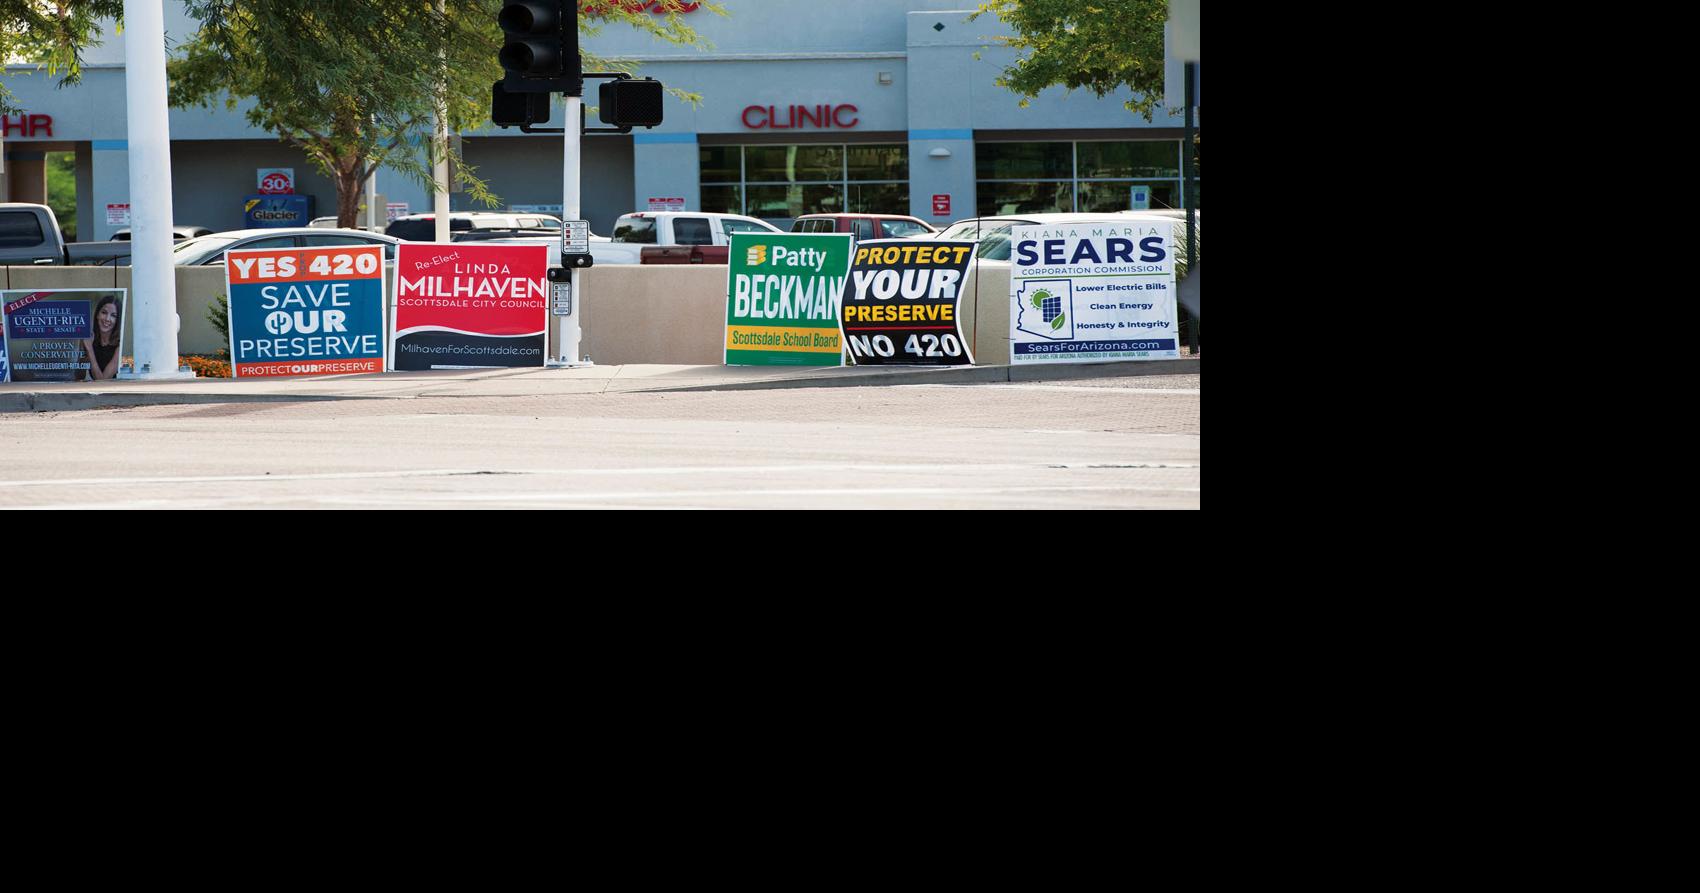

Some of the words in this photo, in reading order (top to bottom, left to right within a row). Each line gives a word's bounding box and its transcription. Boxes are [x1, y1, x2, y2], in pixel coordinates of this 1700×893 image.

[741, 104, 859, 129] CLINIC
[253, 210, 298, 220] Glacier
[1022, 230, 1078, 239] KIANA
[1092, 227, 1159, 236] MARIA
[771, 245, 827, 273] Patty
[855, 246, 970, 266] PROTECT
[1016, 237, 1167, 266] SEARS
[231, 256, 297, 279] YES
[309, 253, 378, 276] 420
[415, 251, 460, 271] Re-Elect
[454, 263, 511, 275] LINDA
[1022, 267, 1091, 276] CORPORATION
[1094, 265, 1163, 274] COMMISSION
[400, 275, 545, 298] MILHAVEN
[853, 269, 961, 300] YOUR
[1107, 283, 1143, 291] Electric
[9, 295, 37, 312] ELECT
[261, 283, 350, 310] SAVE
[399, 298, 469, 308] SCOTTSDALE
[472, 300, 497, 308] CITY
[500, 300, 545, 309] COUNCIL
[734, 273, 843, 320] BECKMAN
[844, 304, 954, 322] PRESERVE
[1120, 302, 1153, 312] Energy
[14, 315, 86, 326] UGENTI-RITA
[264, 309, 348, 335] OUR
[1076, 321, 1116, 331] Honesty
[1118, 321, 1126, 329] &
[1127, 320, 1170, 330] Integrity
[240, 335, 377, 358] PRESERVE
[732, 330, 780, 345] Scottsdale
[783, 332, 811, 347] School
[813, 332, 838, 348] Board
[848, 334, 895, 357] NO
[904, 333, 962, 357] 420
[1028, 341, 1160, 353] SearsForArizona.com
[21, 351, 86, 359] CONSERVATIVE
[401, 343, 541, 356] MilhavenForScottsdale.com
[241, 361, 375, 375] PROTECTOURPRESERVE
